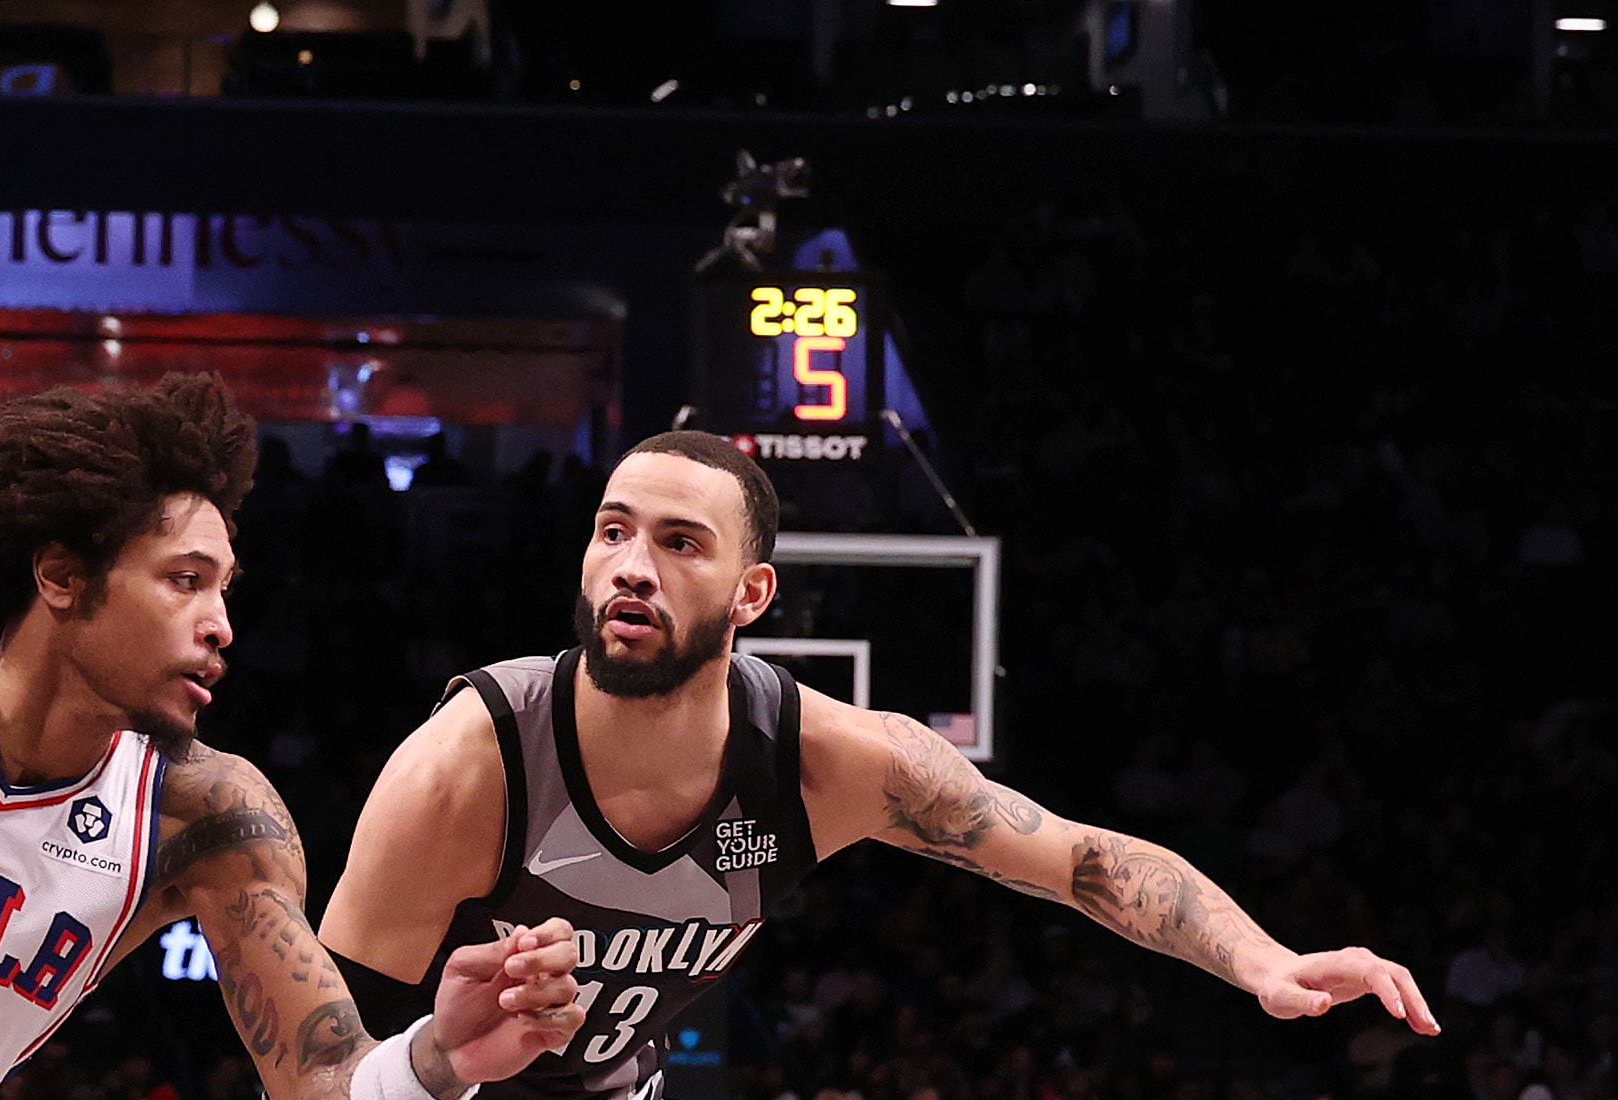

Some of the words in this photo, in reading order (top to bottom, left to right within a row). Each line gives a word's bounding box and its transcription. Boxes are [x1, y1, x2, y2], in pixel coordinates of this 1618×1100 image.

[751, 287, 857, 337] 2:26
[793, 336, 848, 421] 5
[756, 433, 867, 460] TISSOT
[716, 820, 756, 838] GET
[42, 841, 121, 873] crypto.com
[716, 834, 776, 855] YOUR
[716, 848, 778, 872] GUIDE
[492, 918, 763, 977] OOKLYN
